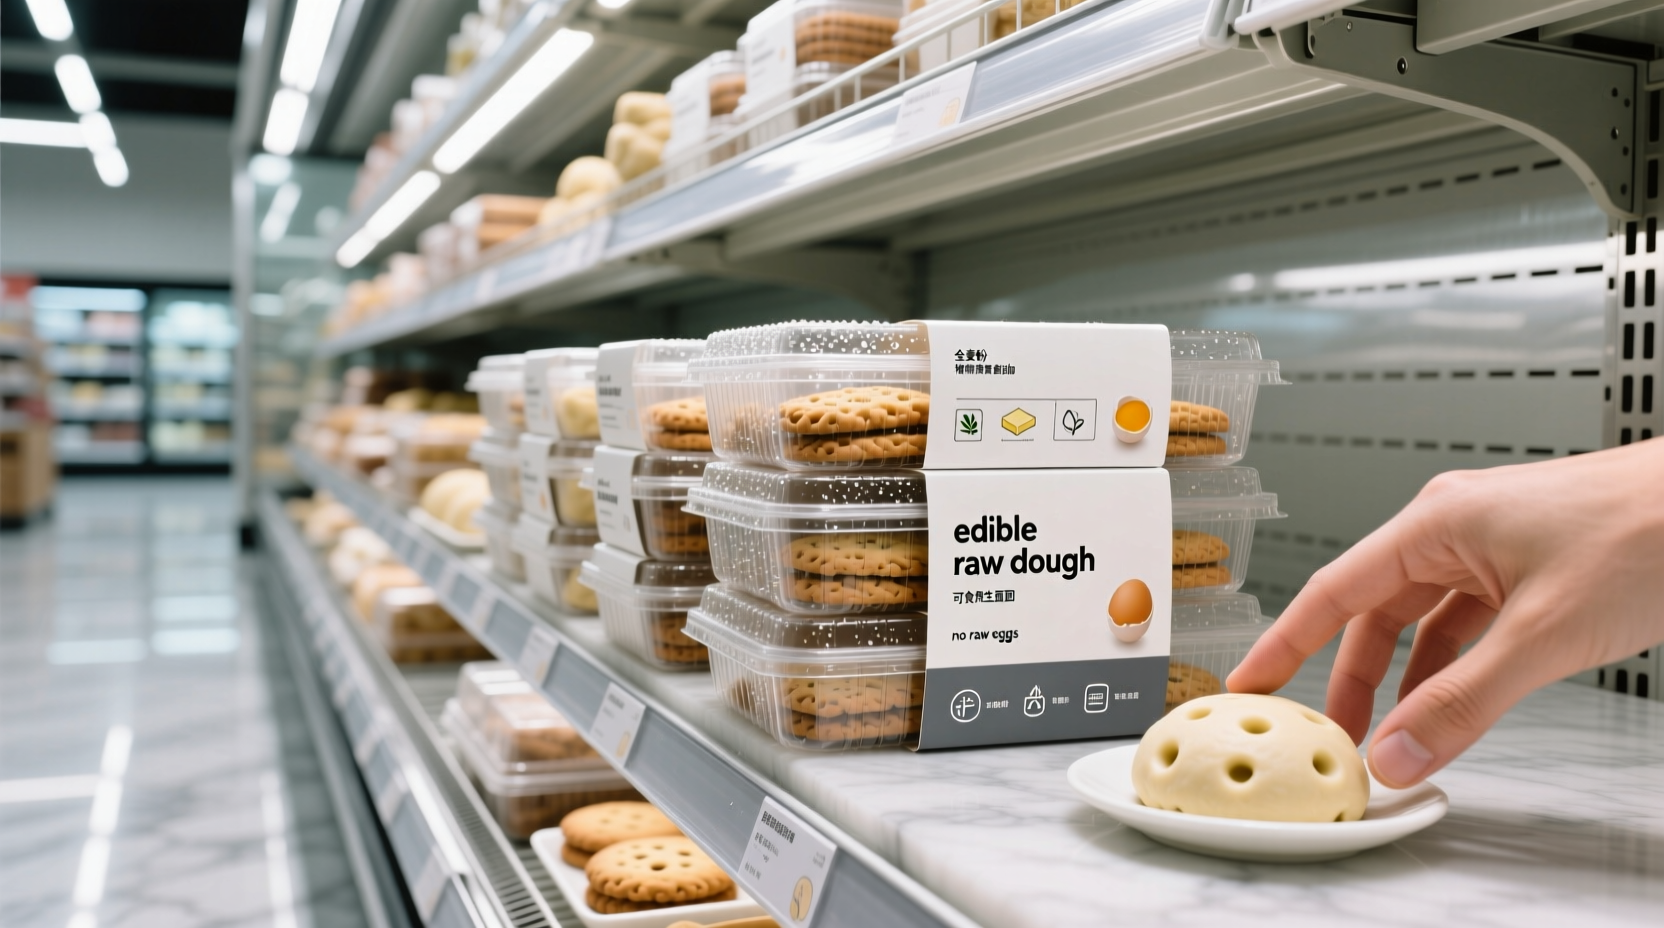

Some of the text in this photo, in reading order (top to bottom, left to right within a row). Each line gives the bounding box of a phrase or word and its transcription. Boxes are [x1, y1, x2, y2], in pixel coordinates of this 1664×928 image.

[953, 514, 1038, 544] edible
[953, 545, 1095, 581] raw dough
[951, 629, 1019, 643] no raw eggs
